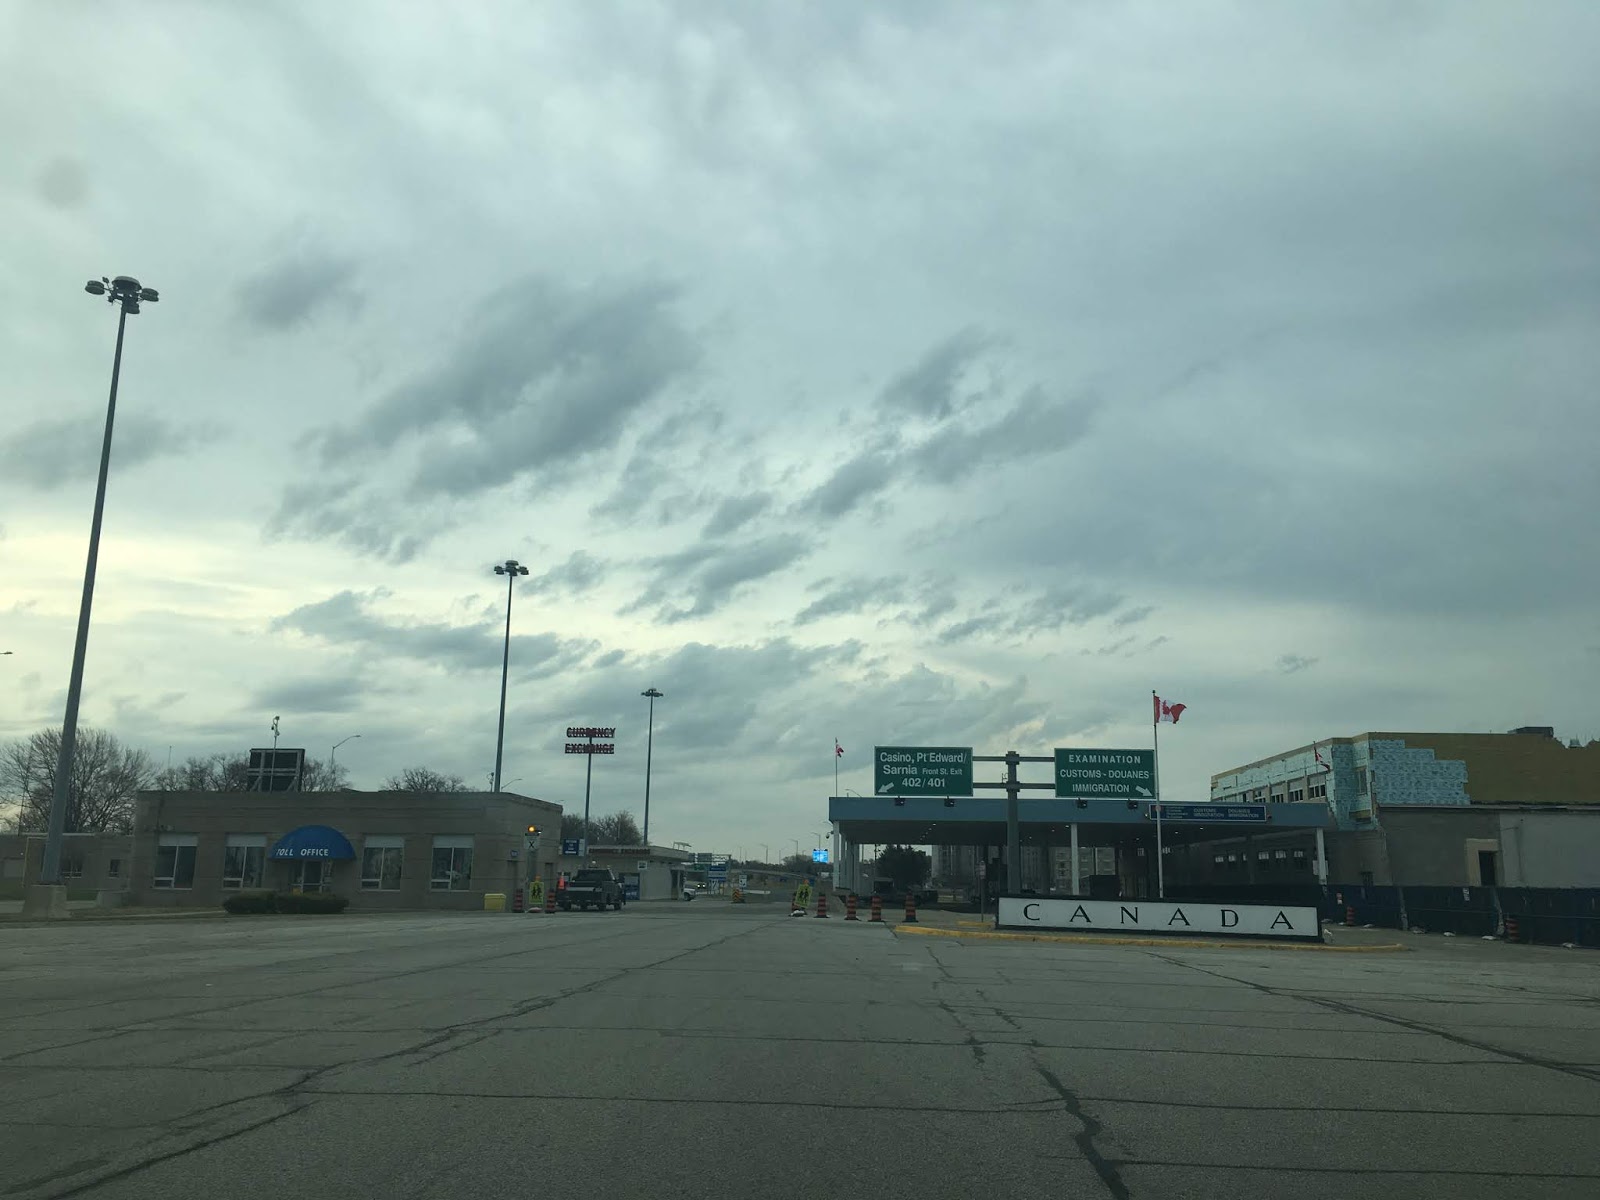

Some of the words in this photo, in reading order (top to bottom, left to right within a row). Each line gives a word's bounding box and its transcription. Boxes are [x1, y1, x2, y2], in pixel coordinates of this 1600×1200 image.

[880, 752, 915, 763] Casino,
[916, 752, 927, 762] Pt
[929, 752, 967, 763] Edward/
[1068, 754, 1141, 764] EXAMINATION
[883, 764, 918, 775] Sarnia
[1060, 769, 1101, 778] CUSTOMS
[1108, 770, 1150, 779] DOUANES
[1072, 783, 1130, 793] IMMIGRATION
[300, 848, 329, 857] OFFICE
[1023, 903, 1294, 930] CANADA
